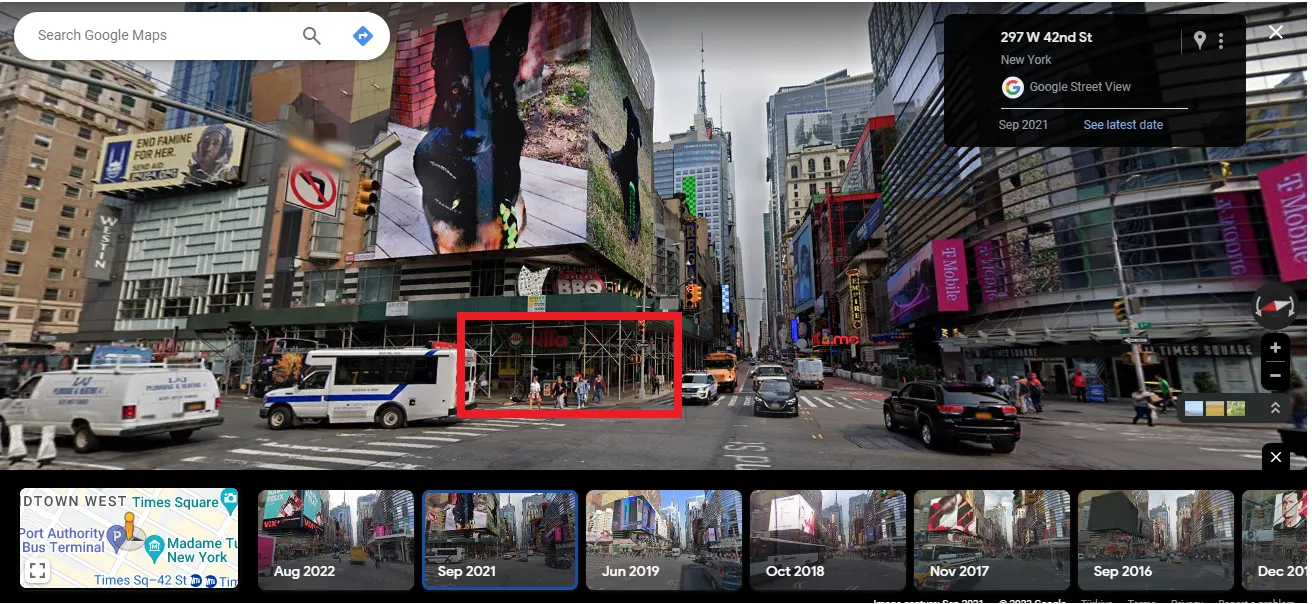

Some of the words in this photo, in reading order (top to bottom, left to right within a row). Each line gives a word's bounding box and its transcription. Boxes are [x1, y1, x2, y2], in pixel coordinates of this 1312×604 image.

[135, 137, 156, 149] END
[156, 132, 193, 147] FAMINE
[133, 149, 155, 161] FOR
[155, 147, 177, 159] HER.
[94, 215, 119, 269] WESTIN
[558, 279, 603, 295] BBQ
[851, 275, 861, 319] EMPIRE
[1158, 345, 1200, 356] TIMES
[1204, 344, 1254, 356] SQUARE
